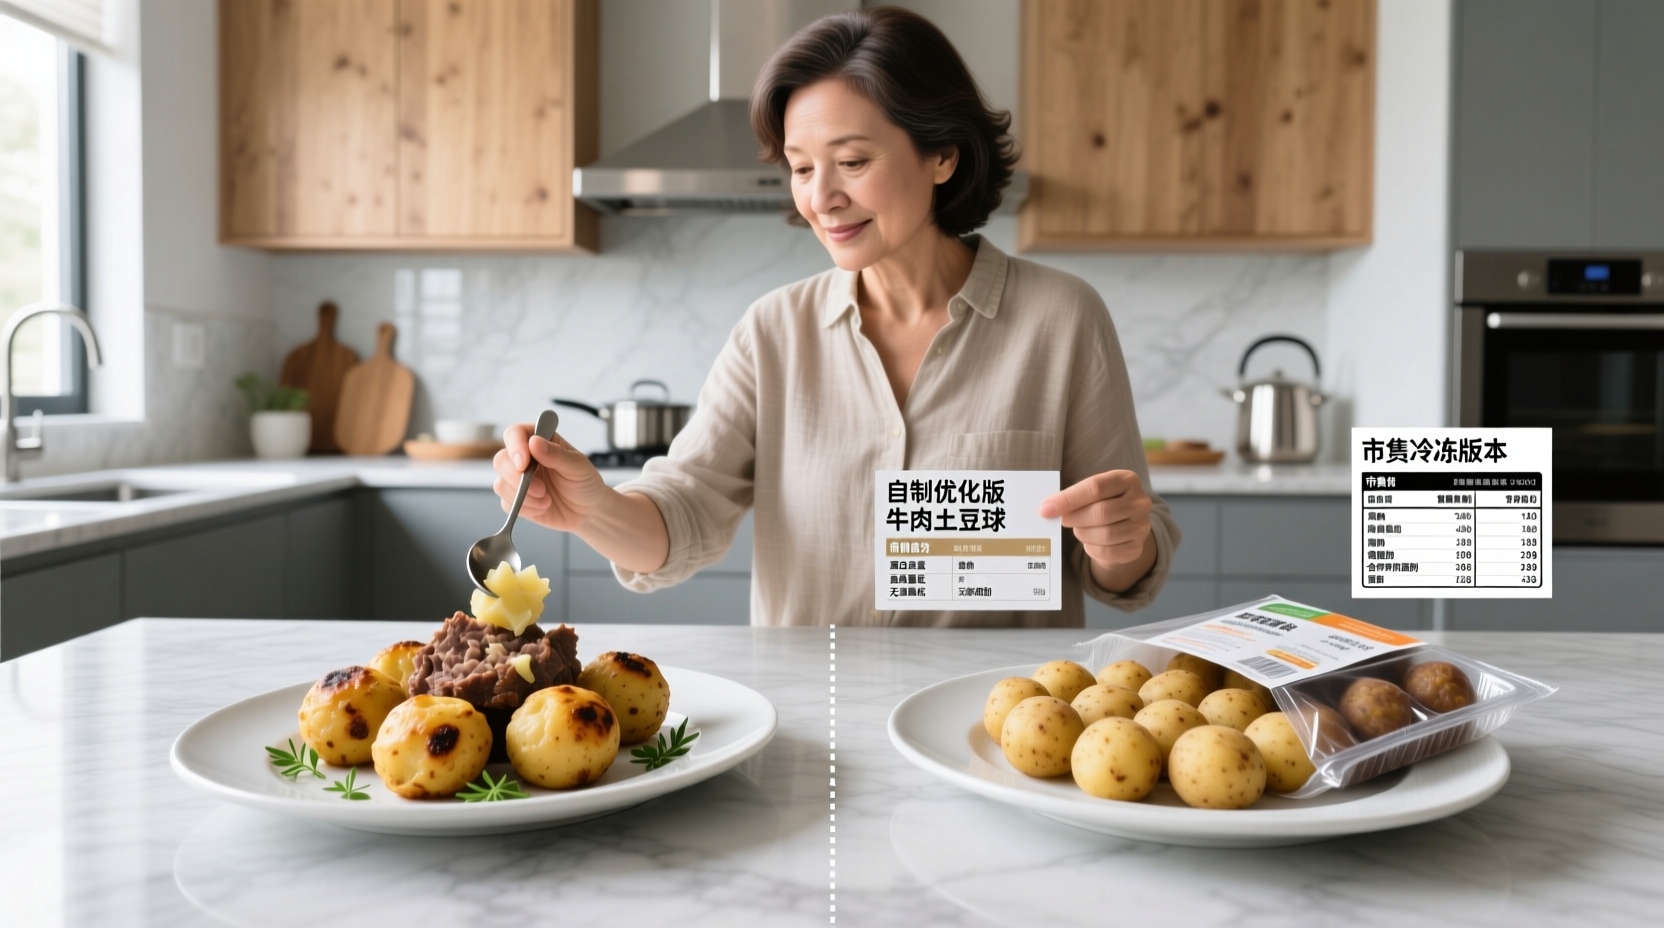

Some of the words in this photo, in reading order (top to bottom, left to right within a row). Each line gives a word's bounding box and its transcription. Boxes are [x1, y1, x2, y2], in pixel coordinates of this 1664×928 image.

[888, 478, 1005, 505] 自制优化版
[886, 507, 1006, 533] 牛肉土豆球
